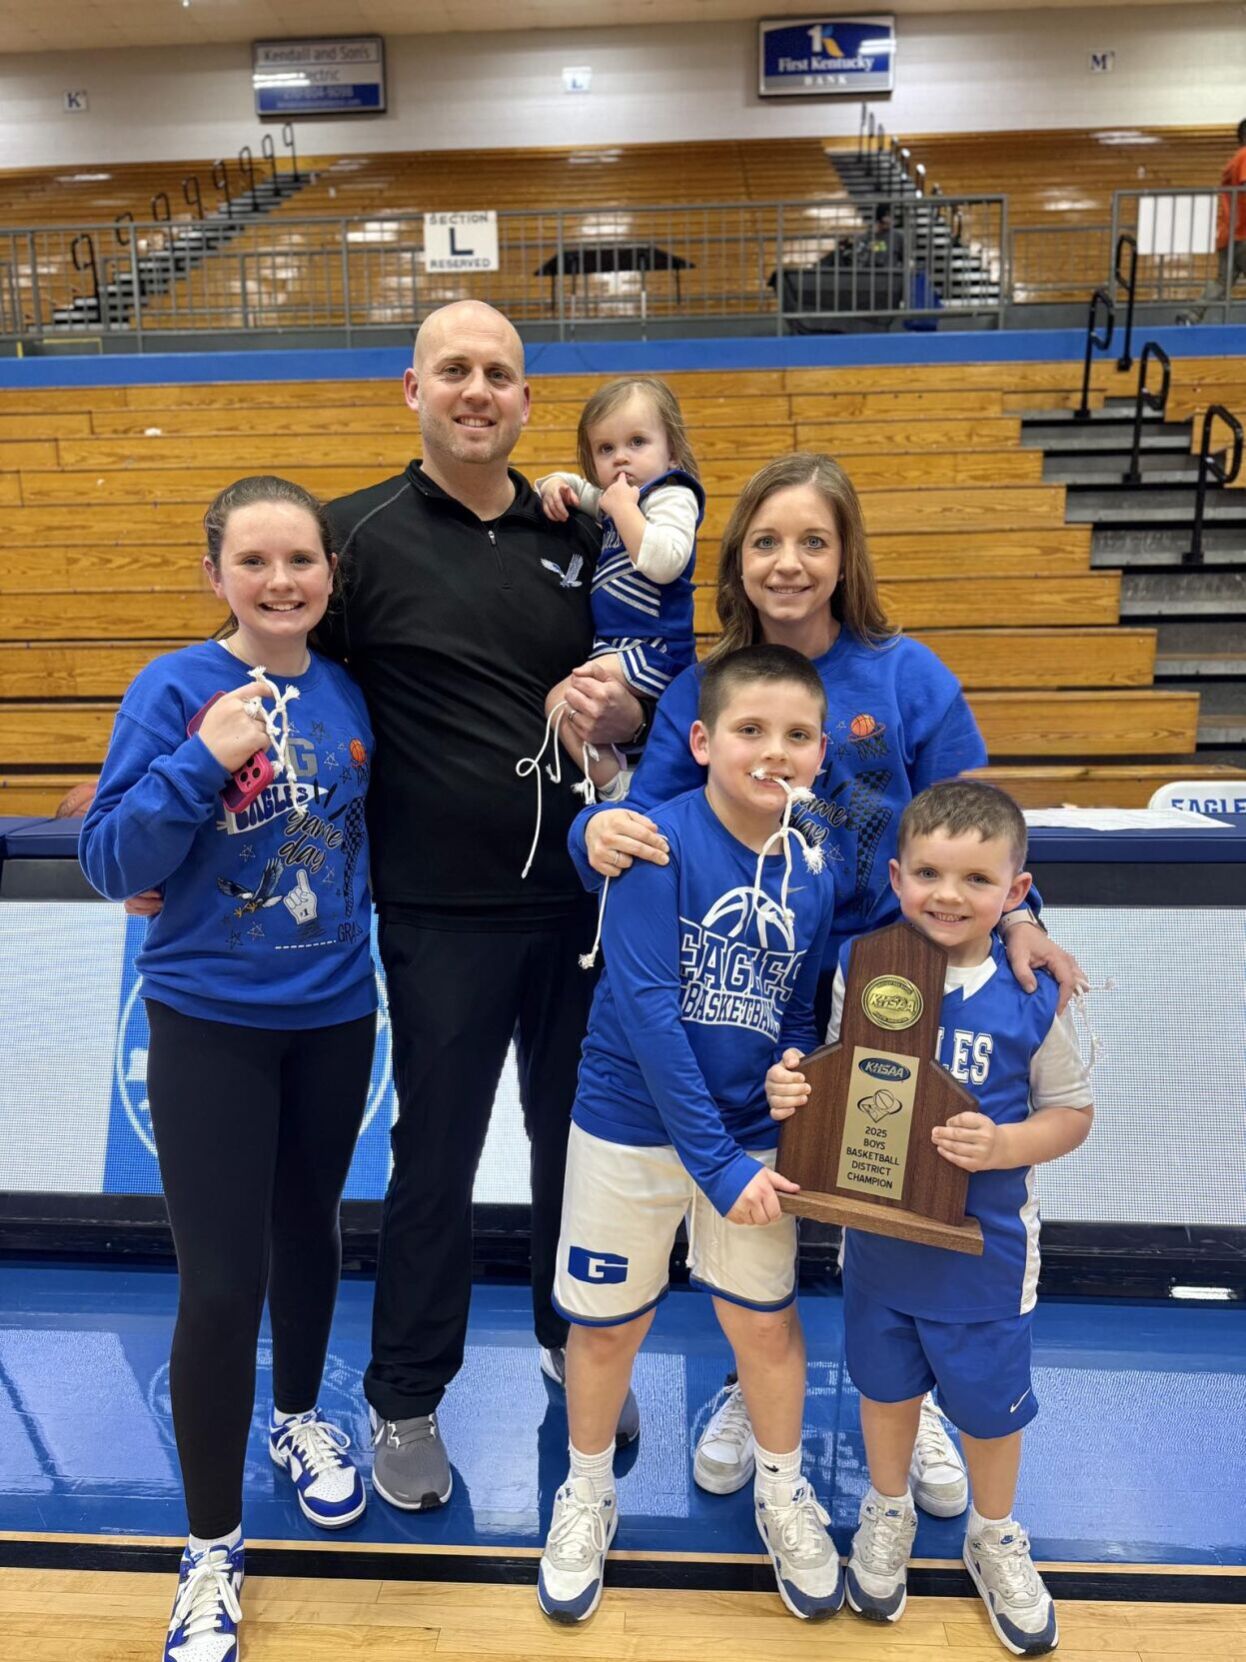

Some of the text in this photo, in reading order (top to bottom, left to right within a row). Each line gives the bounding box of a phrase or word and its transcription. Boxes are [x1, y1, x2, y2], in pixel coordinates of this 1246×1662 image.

[313, 46, 338, 60] and
[779, 54, 875, 72] First Kentucky
[1092, 54, 1107, 70] M
[804, 75, 847, 86] BANK
[68, 92, 81, 108] K
[429, 213, 488, 225] SECTION
[450, 227, 474, 255] L
[430, 258, 491, 269] RESERVED
[284, 810, 344, 848] game
[278, 834, 327, 874] day
[864, 1060, 905, 1079] KHSAA
[864, 1126, 888, 1139] 2025
[863, 1138, 886, 1150] BOYS
[846, 1146, 900, 1166] BASKETBALL
[851, 1160, 892, 1177] DISTRICT
[846, 1171, 893, 1189] CHAMPION
[567, 1245, 629, 1285] G
